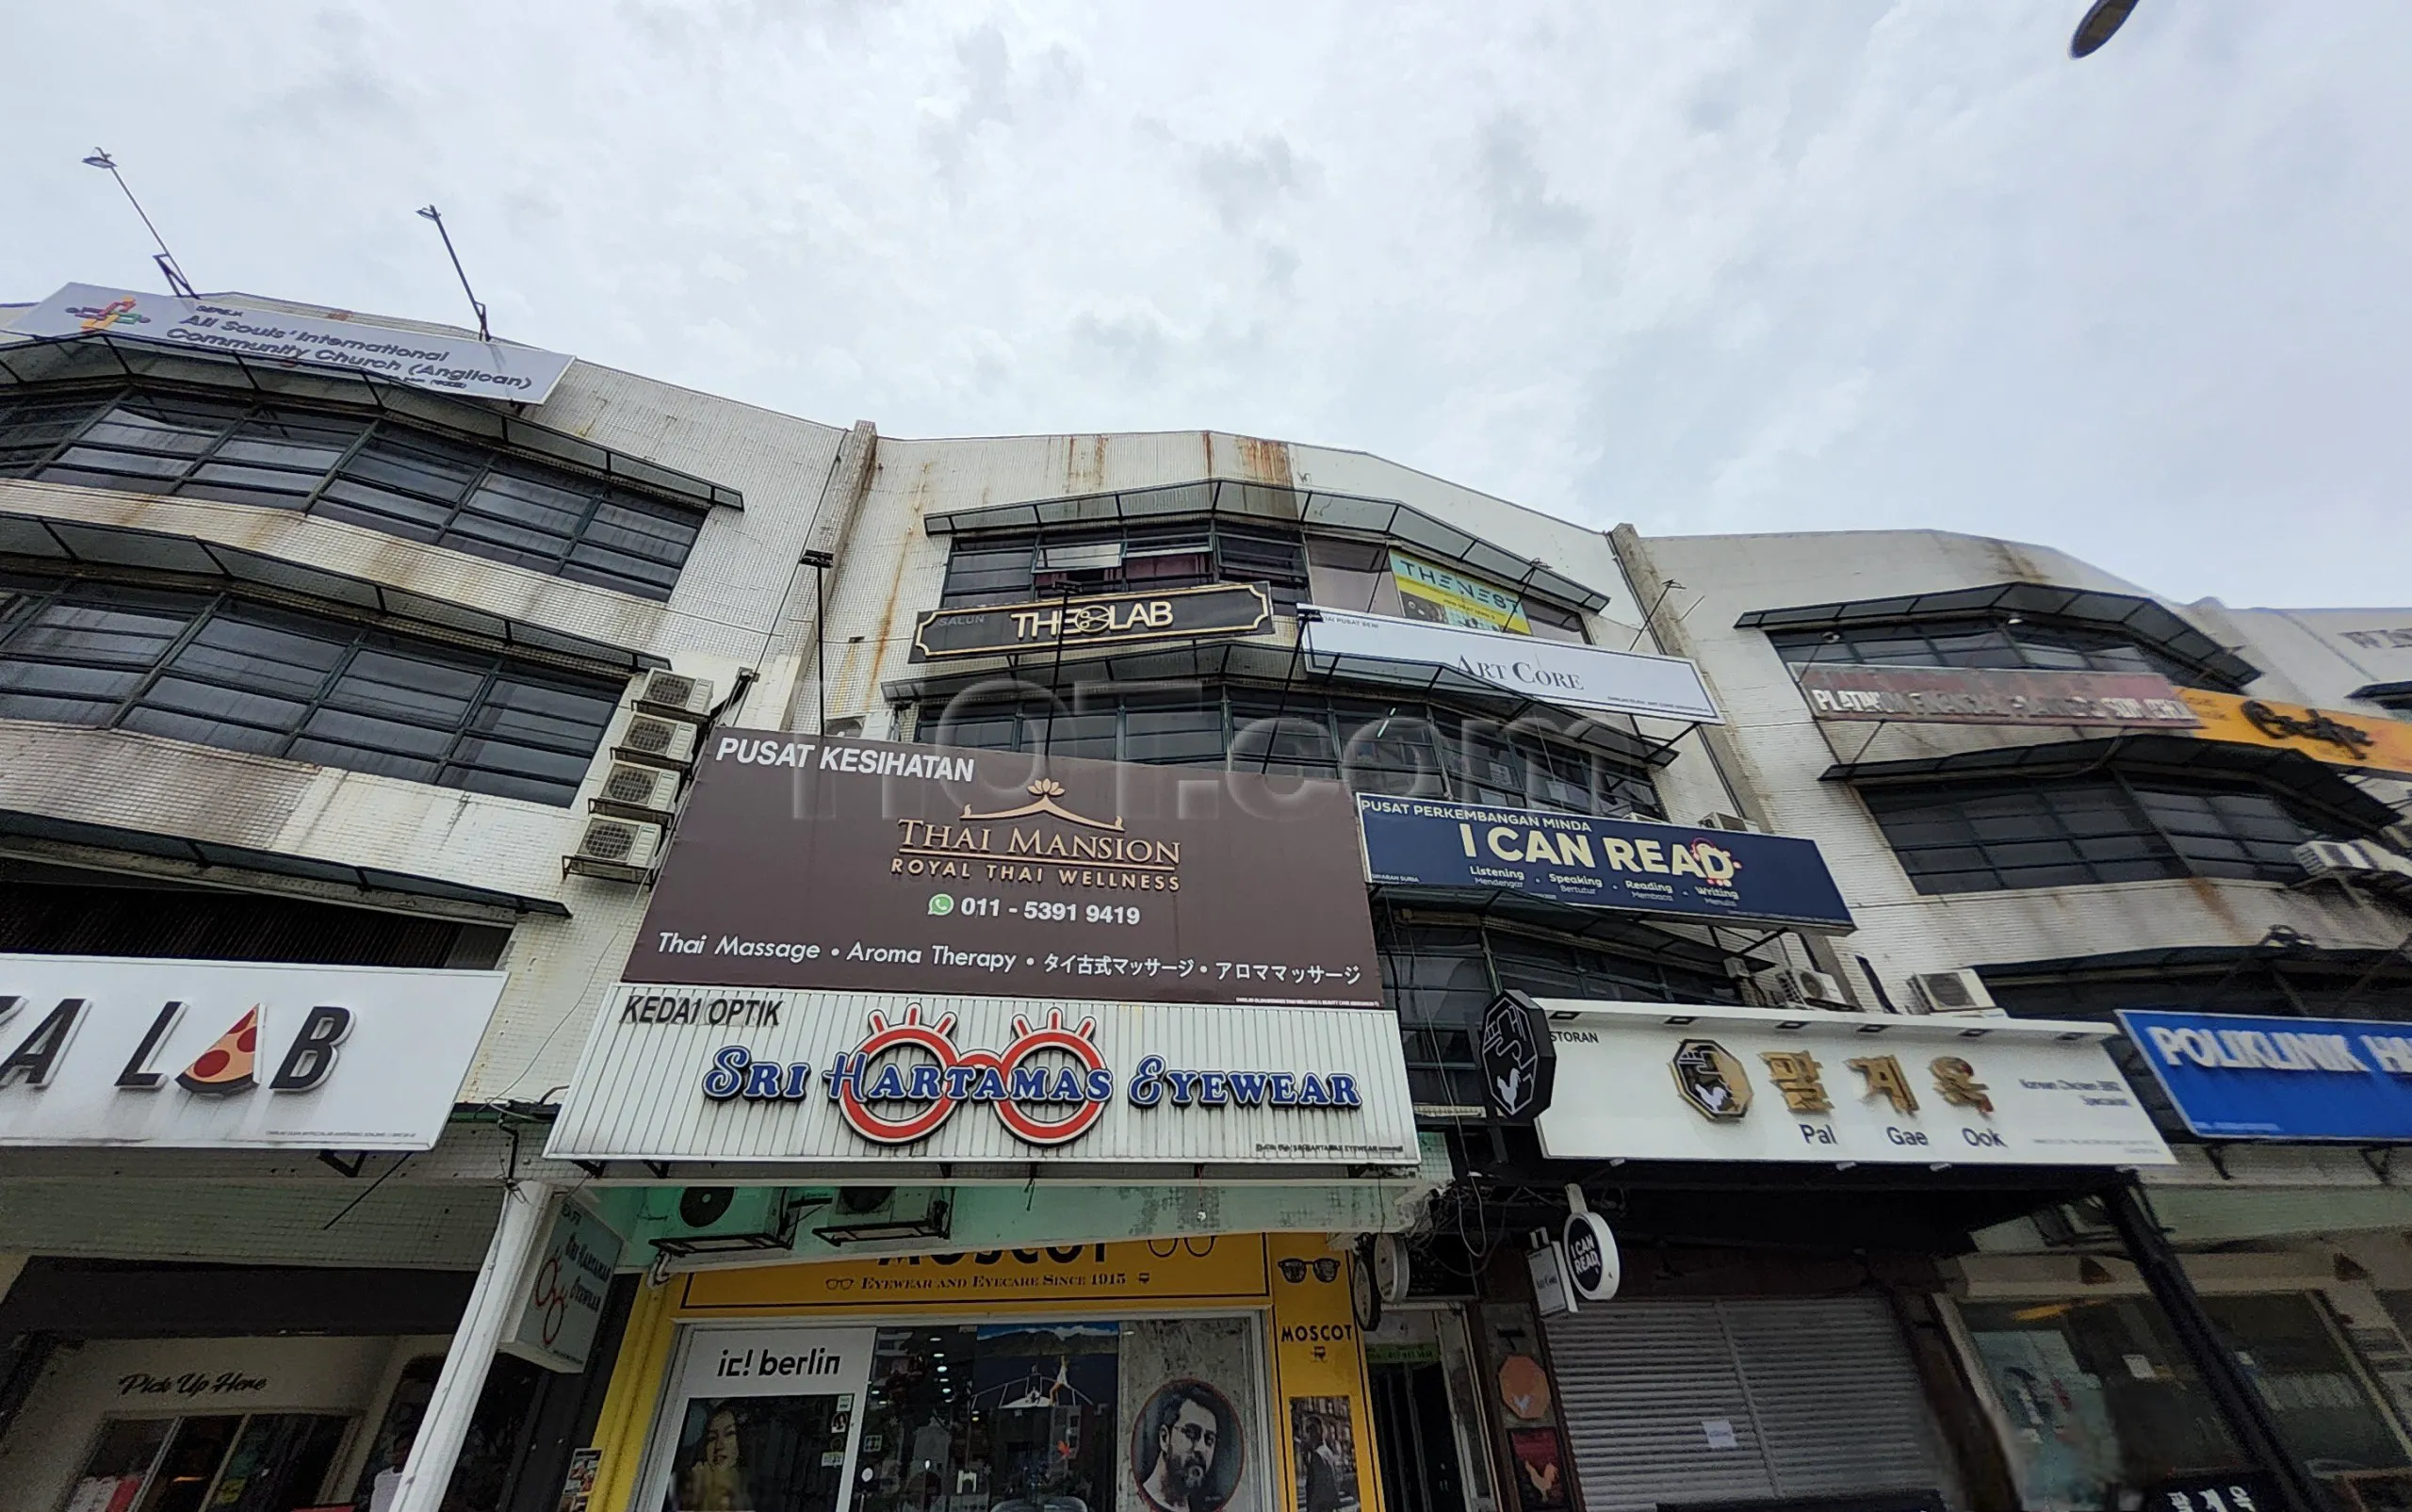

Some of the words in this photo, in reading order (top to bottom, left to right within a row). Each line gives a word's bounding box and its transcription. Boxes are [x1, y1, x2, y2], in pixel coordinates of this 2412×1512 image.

[179, 315, 214, 328] All
[296, 331, 449, 362] International
[167, 328, 312, 359] Community
[315, 348, 402, 371] Church
[408, 363, 532, 390] (Anglican)
[1011, 609, 1082, 640] THE
[1108, 600, 1174, 630] LAB
[1455, 654, 1509, 680] ART
[1511, 661, 1585, 691] CORE
[715, 737, 816, 768] PUSAT
[819, 746, 974, 783] KESIHATAN
[1360, 798, 1410, 815] PUSAT
[1413, 804, 1540, 827] PERKEMBANGAN
[1542, 817, 1592, 833] MINDA
[897, 818, 991, 852] THAI
[1006, 827, 1181, 865] MANSION
[1459, 822, 1477, 857] I
[1487, 826, 1596, 869] CAN
[1602, 837, 1735, 880] READ
[889, 858, 971, 878] ROYAL
[986, 864, 1043, 883] THAI
[1057, 870, 1181, 891] WELLNESS
[1469, 866, 1525, 882] Listening
[1548, 873, 1604, 888] Speaking
[1624, 880, 1674, 894] Reading
[1694, 886, 1740, 900] Writing
[960, 897, 1000, 917] 011
[1023, 901, 1077, 922] 5391
[1084, 903, 1141, 925] 9419
[658, 932, 707, 955] Thai
[714, 937, 821, 964] Massage
[846, 941, 921, 964] Aroma
[931, 945, 1017, 973] Therapy
[1043, 952, 1195, 978] タイ古式マッサージ
[1214, 960, 1361, 985] アロママッサージ
[621, 996, 702, 1024] KEDAI
[708, 998, 786, 1027] OPTIK
[1550, 1031, 1600, 1044] STORAN
[2145, 1025, 2372, 1073] POLIKLINIK
[702, 1044, 812, 1101] SRI
[822, 1049, 1114, 1102] HARTAMAS
[1128, 1053, 1362, 1107] EYEWEAR
[1799, 1122, 1838, 1146] Pal
[1885, 1126, 1930, 1146] Gae
[1961, 1126, 2008, 1147] Ook
[1574, 1232, 1596, 1257] CAN
[1573, 1249, 1602, 1276] READ
[860, 1276, 934, 1291] EYEWEAR
[937, 1276, 967, 1289] AND
[971, 1275, 1039, 1289] EYECARE
[1042, 1273, 1086, 1287] SINCE
[1090, 1272, 1127, 1285] 1915
[1280, 1324, 1352, 1342] MOSCOT
[717, 1349, 754, 1376] ic!
[758, 1347, 841, 1376] berlin
[117, 1373, 172, 1395] Pick
[176, 1371, 210, 1397] Up
[211, 1371, 268, 1393] Here
